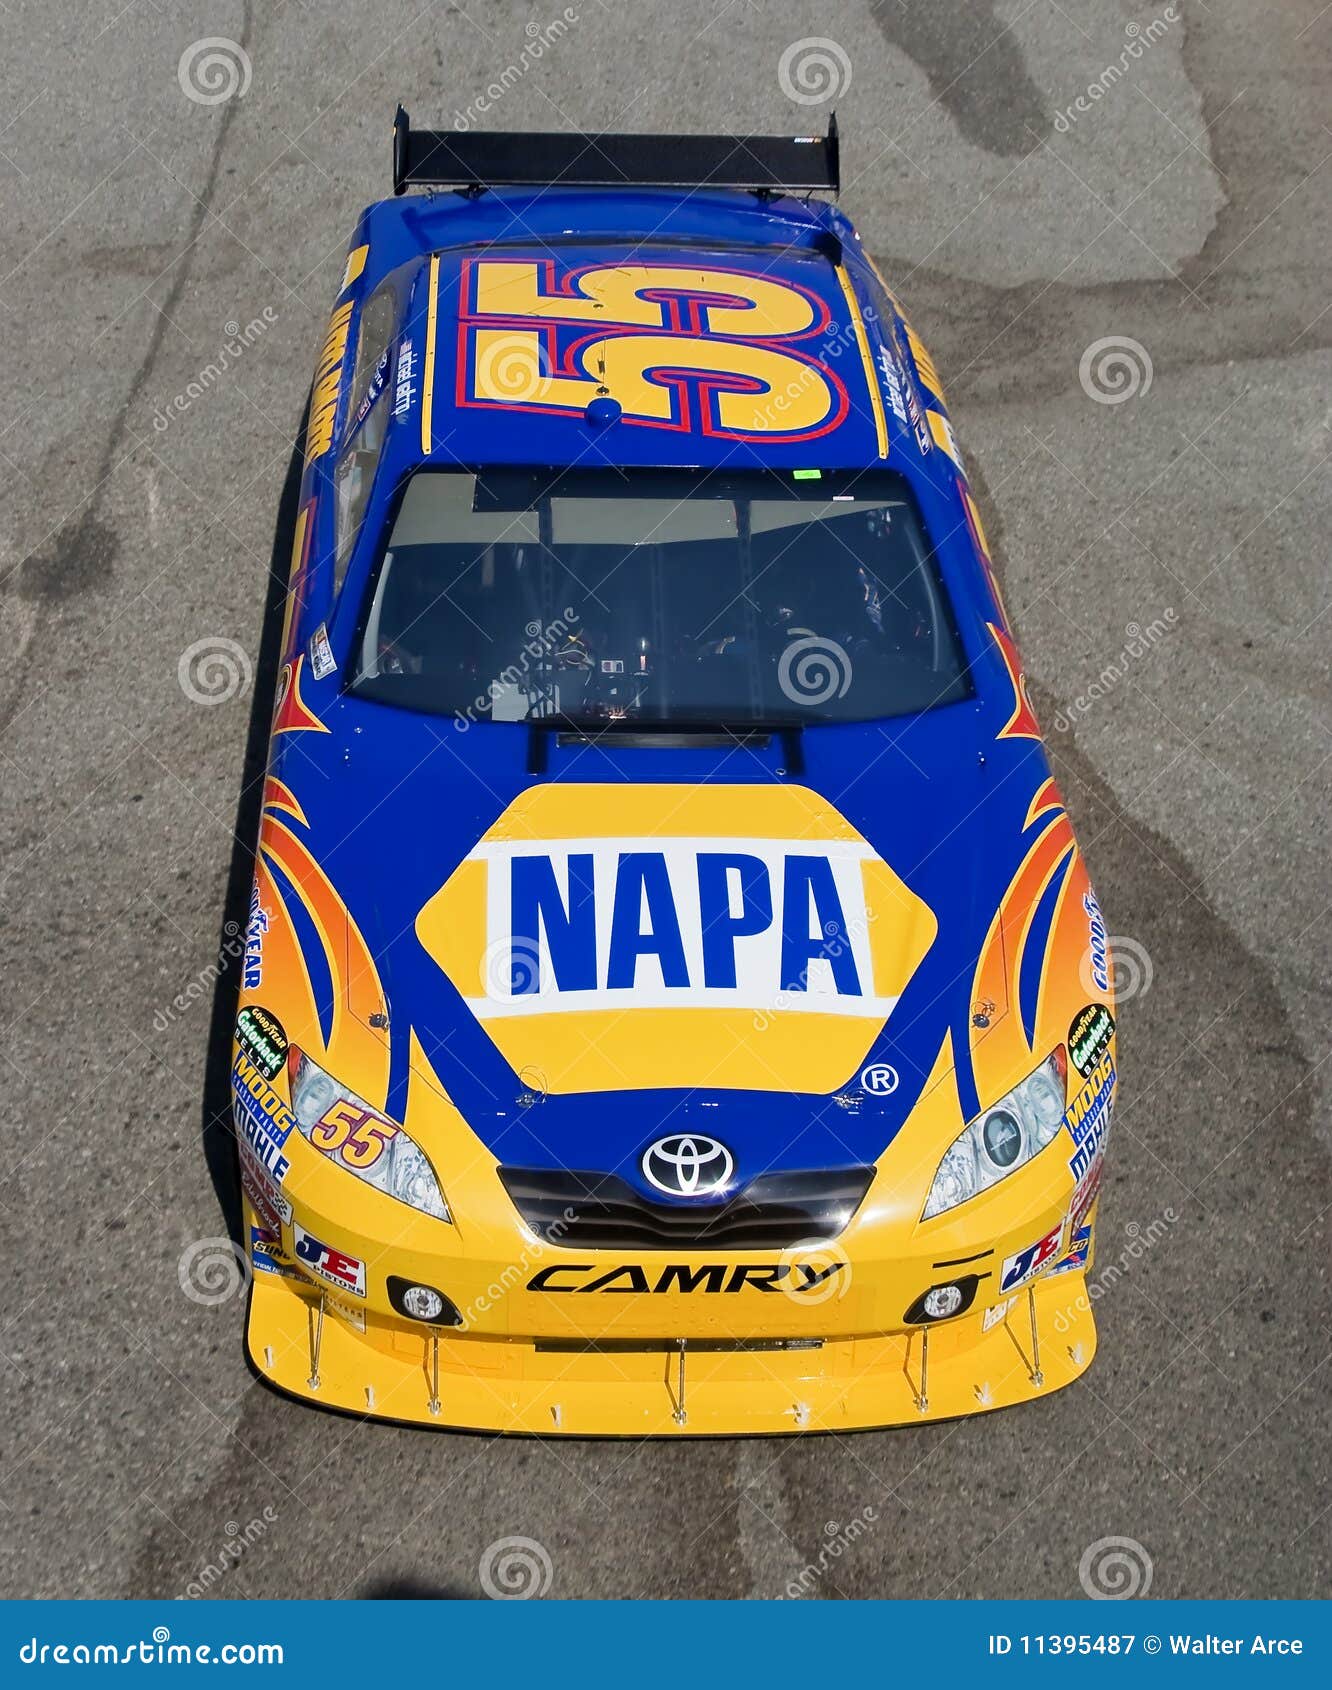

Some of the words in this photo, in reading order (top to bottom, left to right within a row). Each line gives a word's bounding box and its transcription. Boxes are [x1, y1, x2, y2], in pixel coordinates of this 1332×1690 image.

[510, 852, 863, 997] NAPA
[235, 1026, 271, 1078] BELTS
[237, 1011, 285, 1071] Gatorback
[251, 1007, 287, 1050] GOODYEAR
[1069, 1005, 1098, 1048] GOODYEAR
[1083, 1026, 1114, 1076] BELTS
[234, 1055, 297, 1133] MOOG
[1066, 1050, 1115, 1129] MOOG
[232, 1096, 290, 1184] MAHLE
[309, 1098, 398, 1170] 55
[296, 1234, 360, 1285] JE
[313, 1264, 365, 1296] PISTONS
[526, 1264, 848, 1294] CAMRY
[1001, 1223, 1062, 1291] JE
